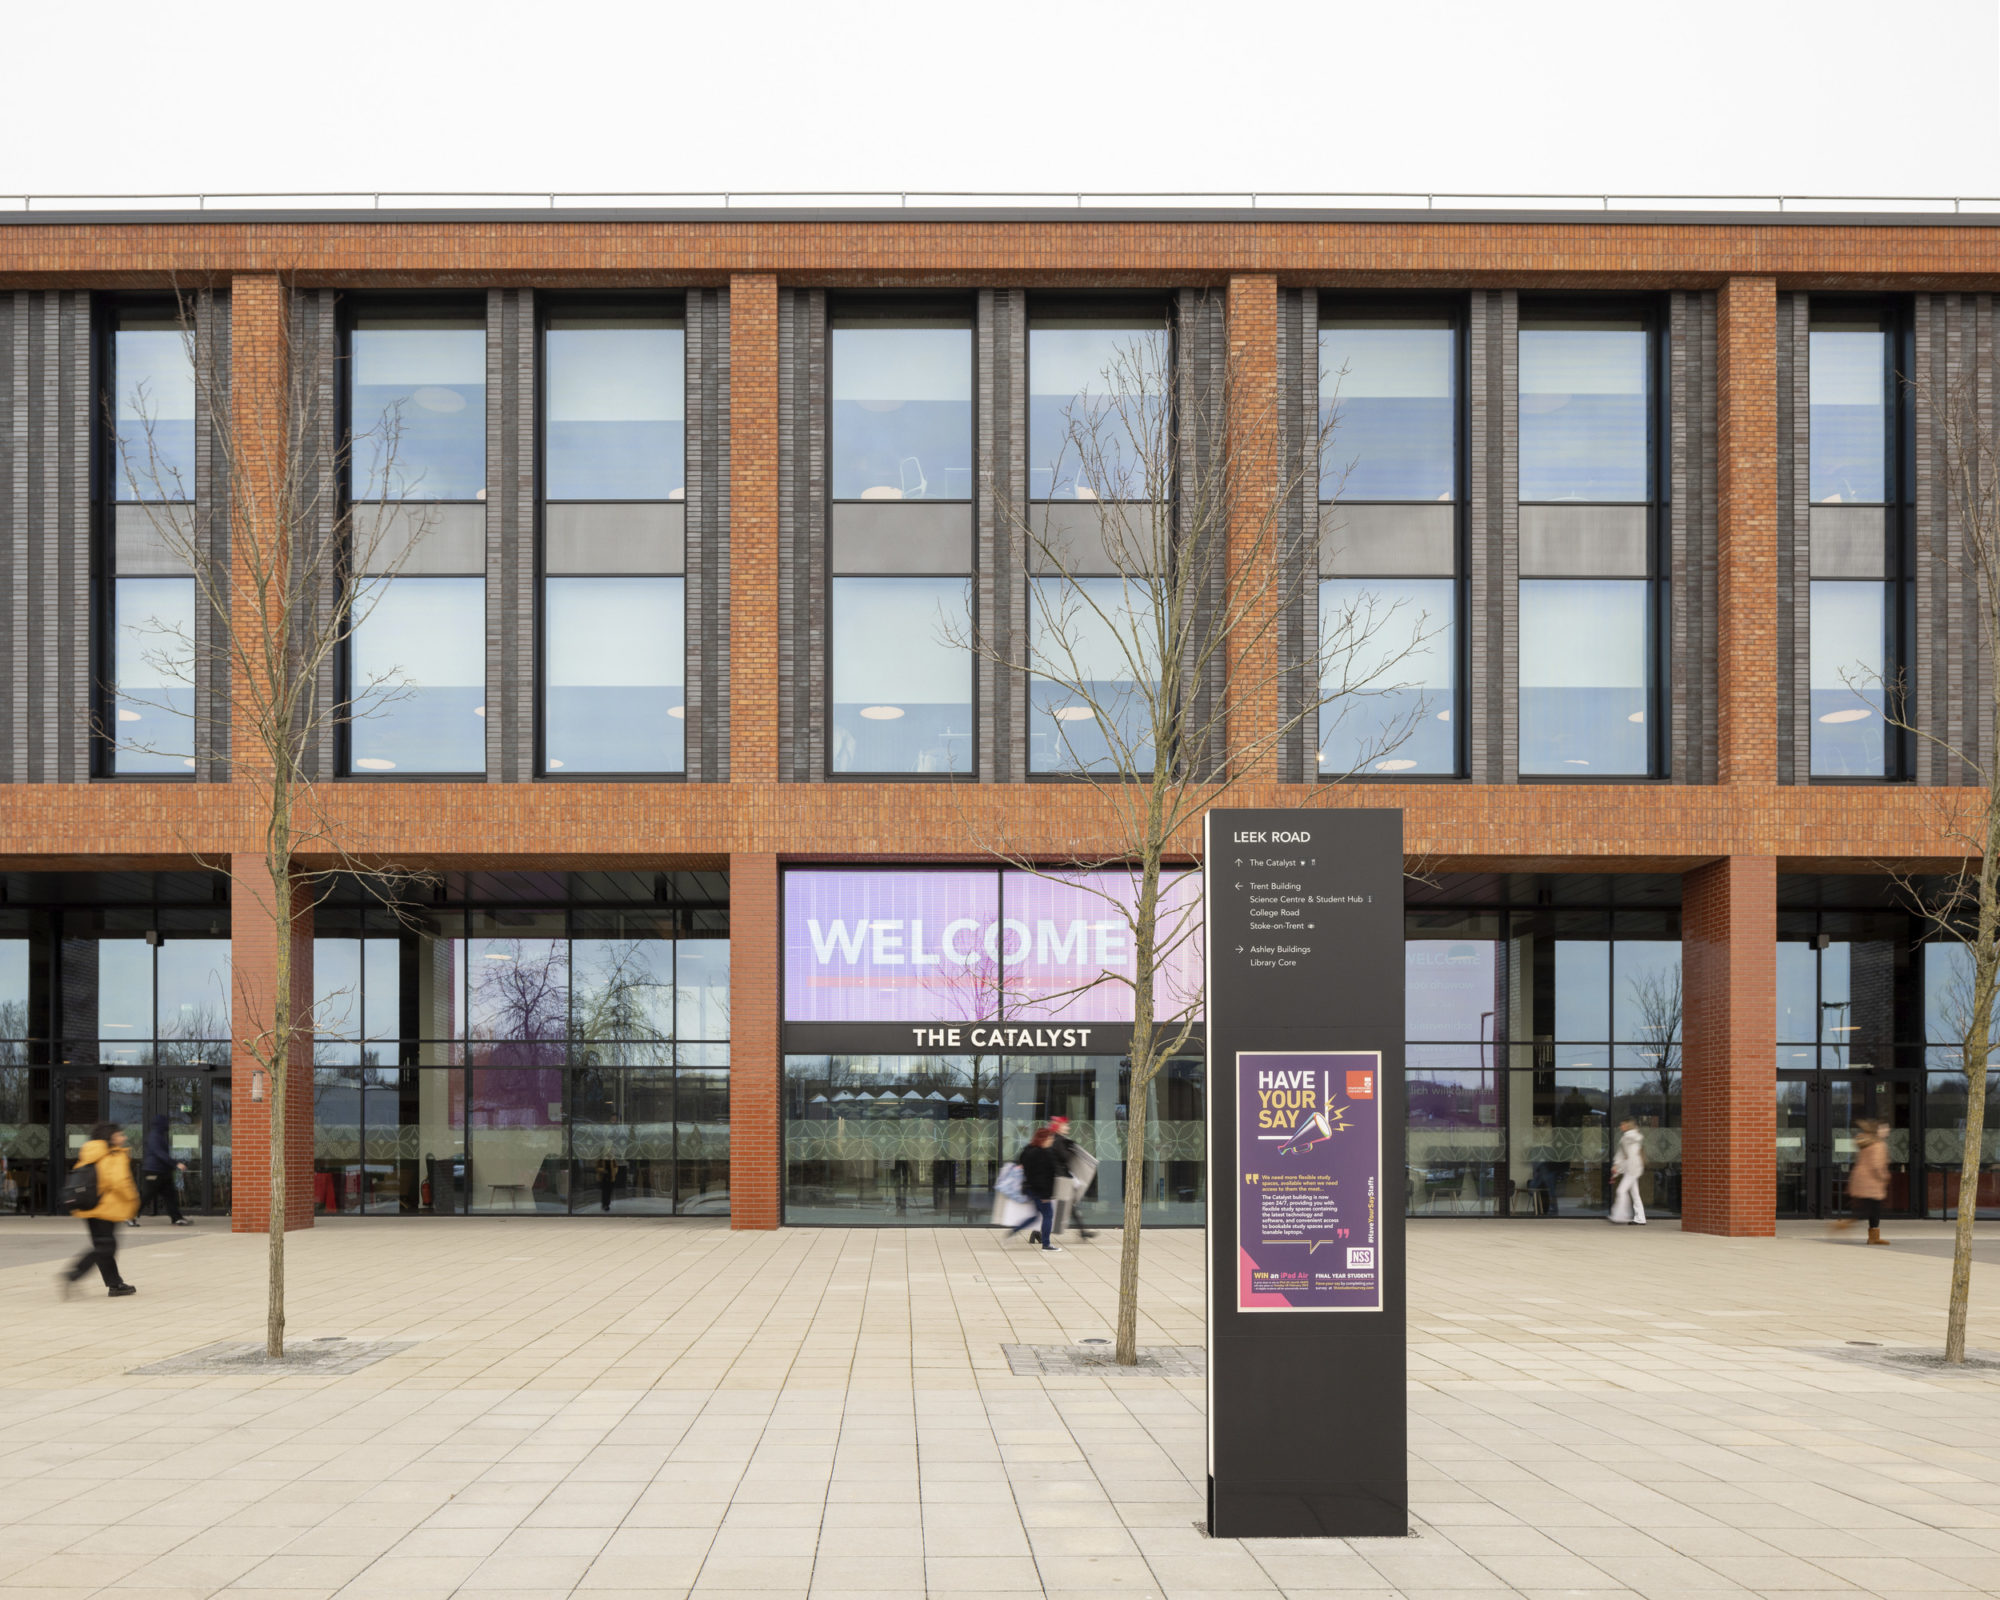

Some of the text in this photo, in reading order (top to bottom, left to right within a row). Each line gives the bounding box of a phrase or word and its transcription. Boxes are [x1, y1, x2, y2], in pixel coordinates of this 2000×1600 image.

[1234, 832, 1311, 843] LEEK ROAD
[1266, 859, 1296, 867] Catalyst
[1250, 882, 1301, 891] Trent Building
[1250, 909, 1278, 918] College
[1250, 922, 1304, 930] Stoke-on-Trent
[808, 918, 1127, 965] WELCOME
[1250, 946, 1311, 954] Ashley Buildings
[1250, 959, 1276, 968] Library
[913, 1028, 1091, 1048] THE CATALYST
[1259, 1071, 1315, 1089] HAVE
[1258, 1090, 1316, 1108] YOUR
[1258, 1110, 1299, 1128] SAY
[1353, 1251, 1370, 1262] NSS
